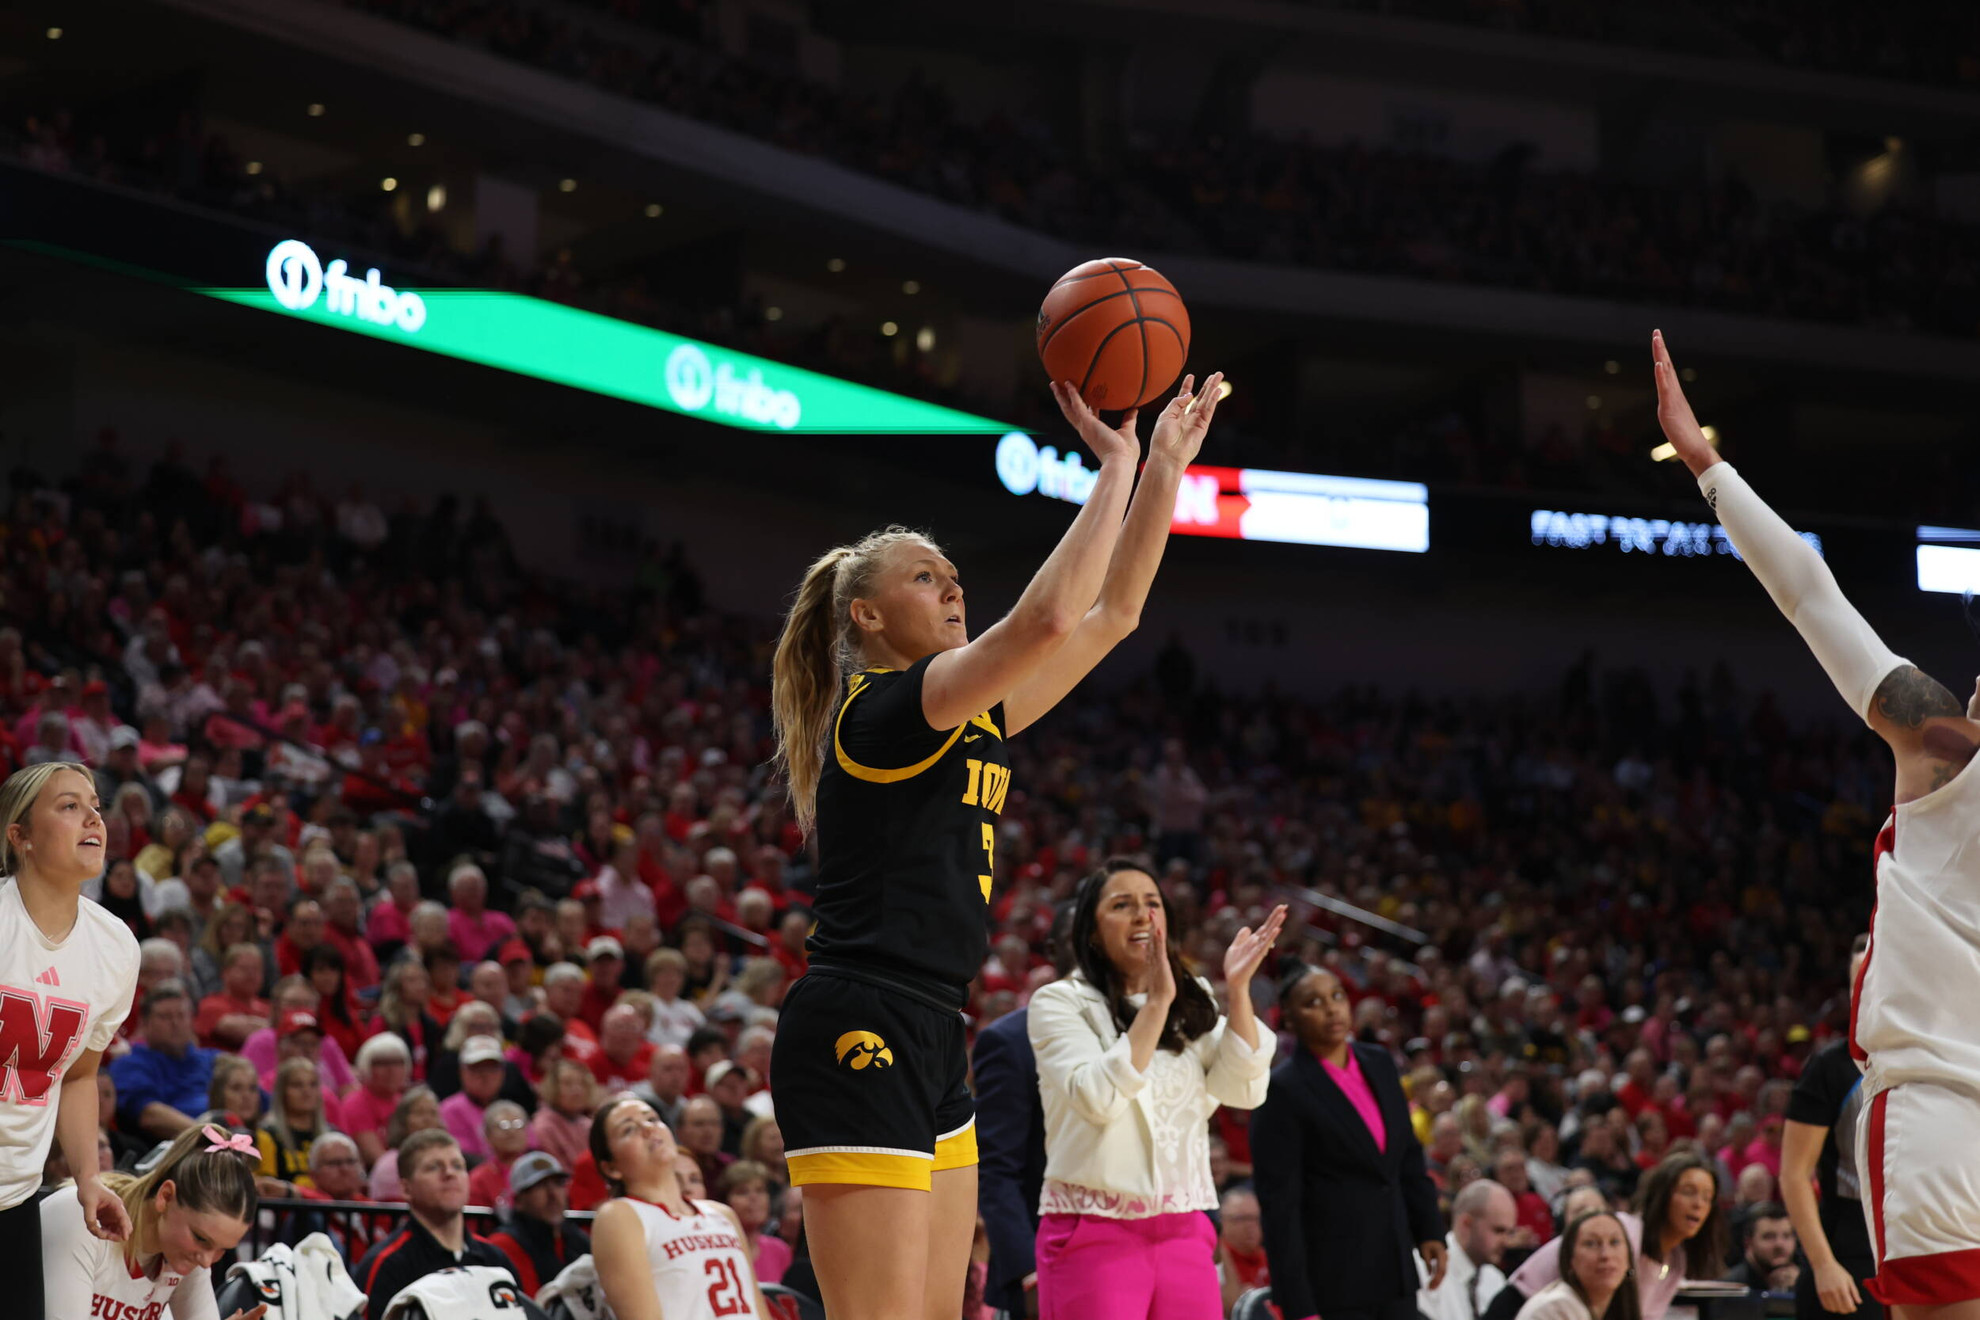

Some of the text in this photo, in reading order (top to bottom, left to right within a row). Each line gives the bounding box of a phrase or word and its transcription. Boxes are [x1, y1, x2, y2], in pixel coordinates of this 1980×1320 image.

[323, 259, 426, 333] fnbo
[0, 985, 89, 1107] N
[705, 1257, 751, 1317] 21
